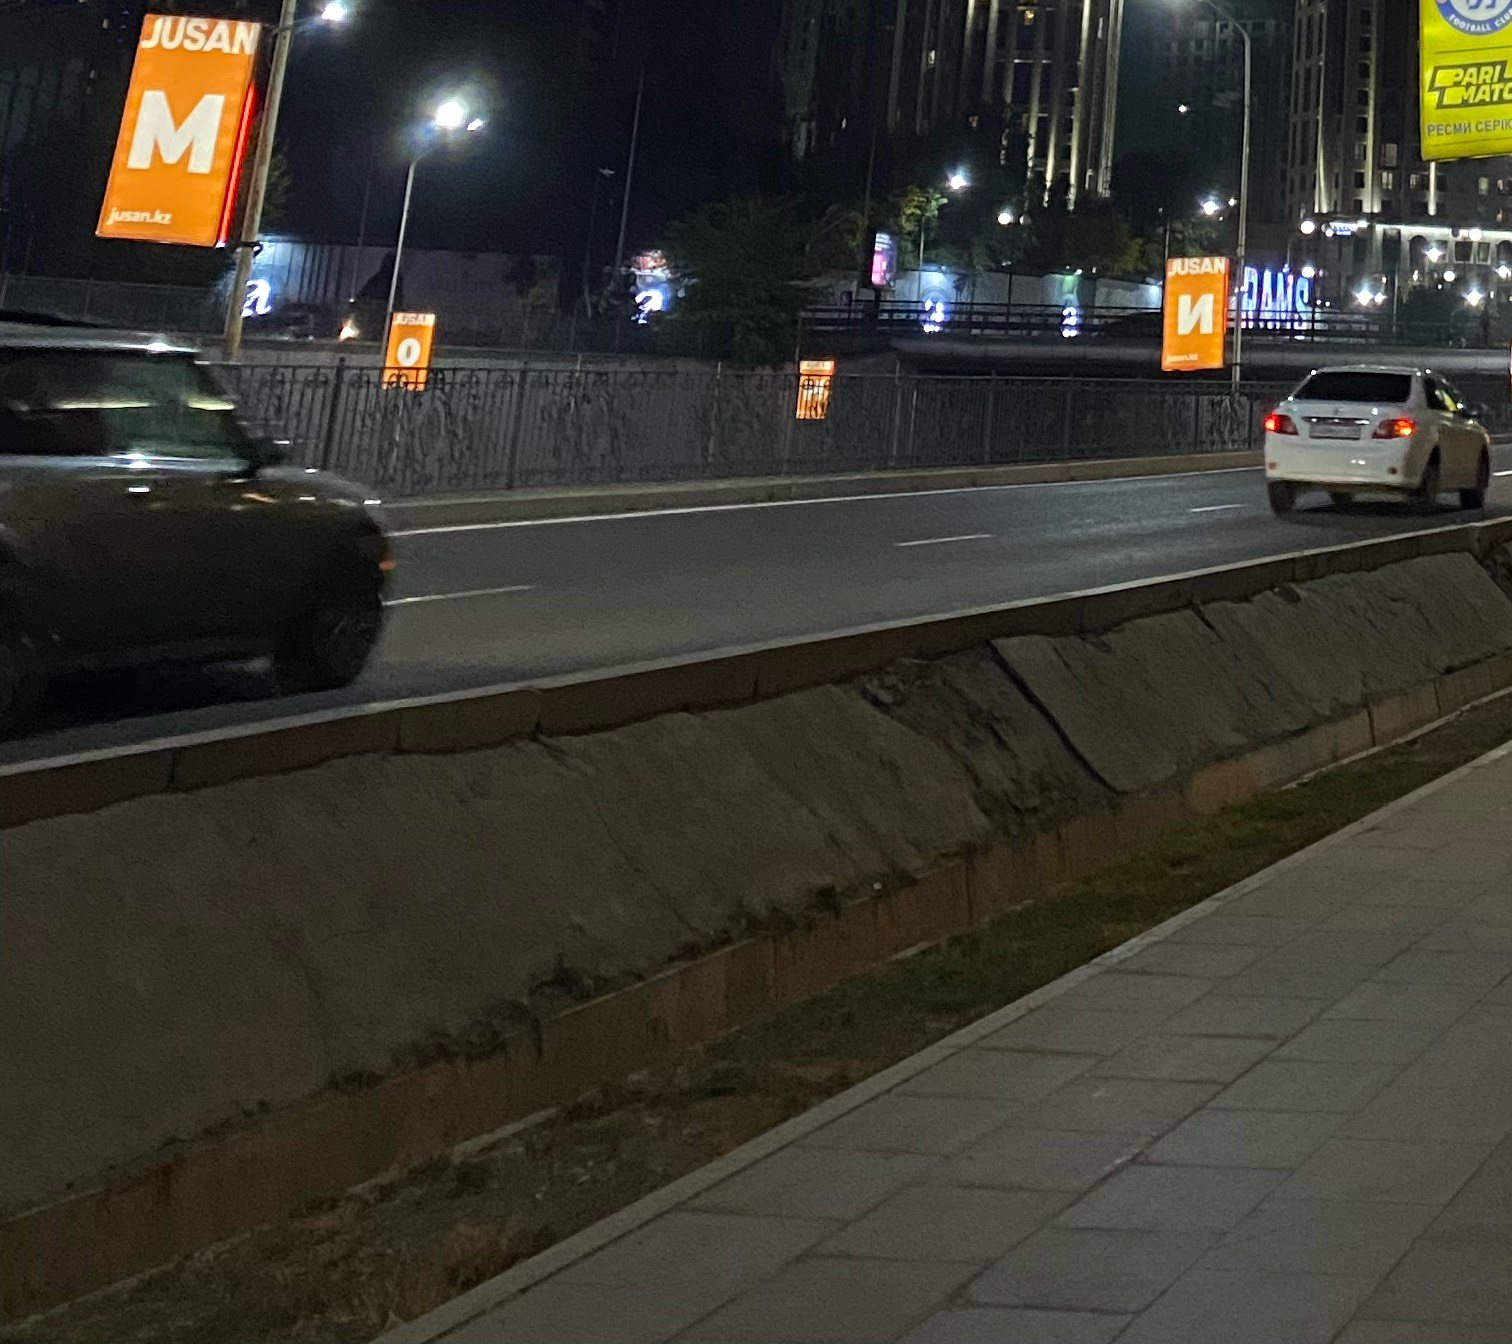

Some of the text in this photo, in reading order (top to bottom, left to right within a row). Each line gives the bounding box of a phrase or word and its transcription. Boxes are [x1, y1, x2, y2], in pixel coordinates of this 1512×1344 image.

[1448, 13, 1492, 32] FOOTBALL
[141, 15, 261, 55] JUSAN
[1434, 64, 1502, 87] PARI
[1168, 257, 1226, 276] JUSAN
